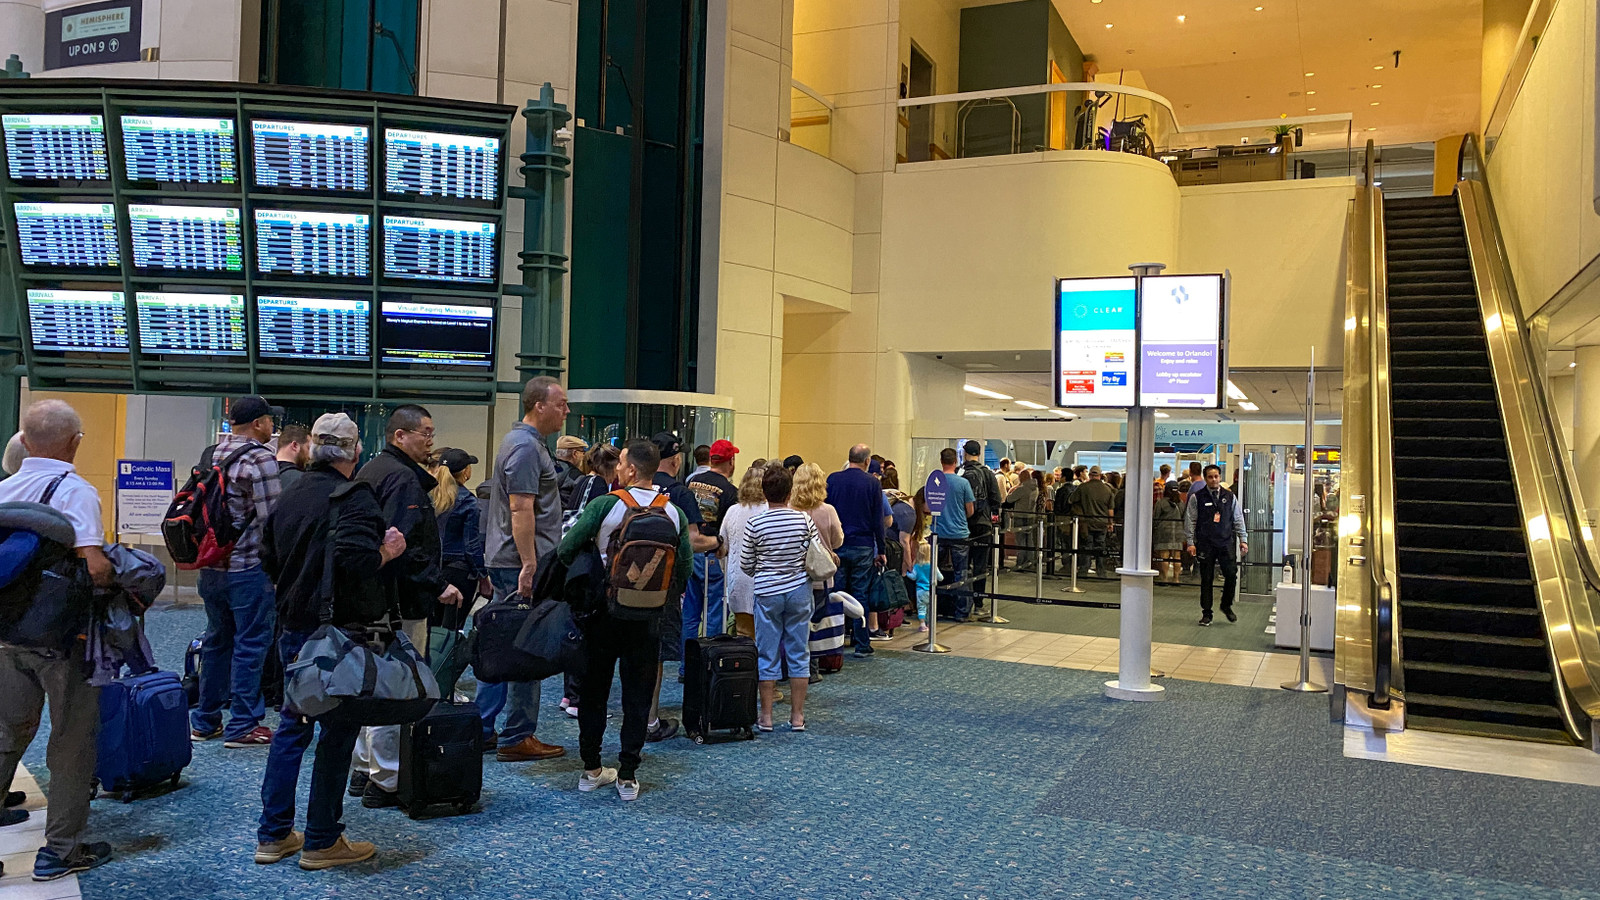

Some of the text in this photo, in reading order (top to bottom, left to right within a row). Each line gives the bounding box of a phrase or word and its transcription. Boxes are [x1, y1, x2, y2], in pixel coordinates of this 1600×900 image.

[80, 12, 125, 25] HEMISPHERE
[68, 41, 105, 57] UP ON 9
[254, 123, 295, 132] DEPARTURES
[388, 132, 428, 140] DEPARTURES
[385, 218, 426, 226] DEPARTURES
